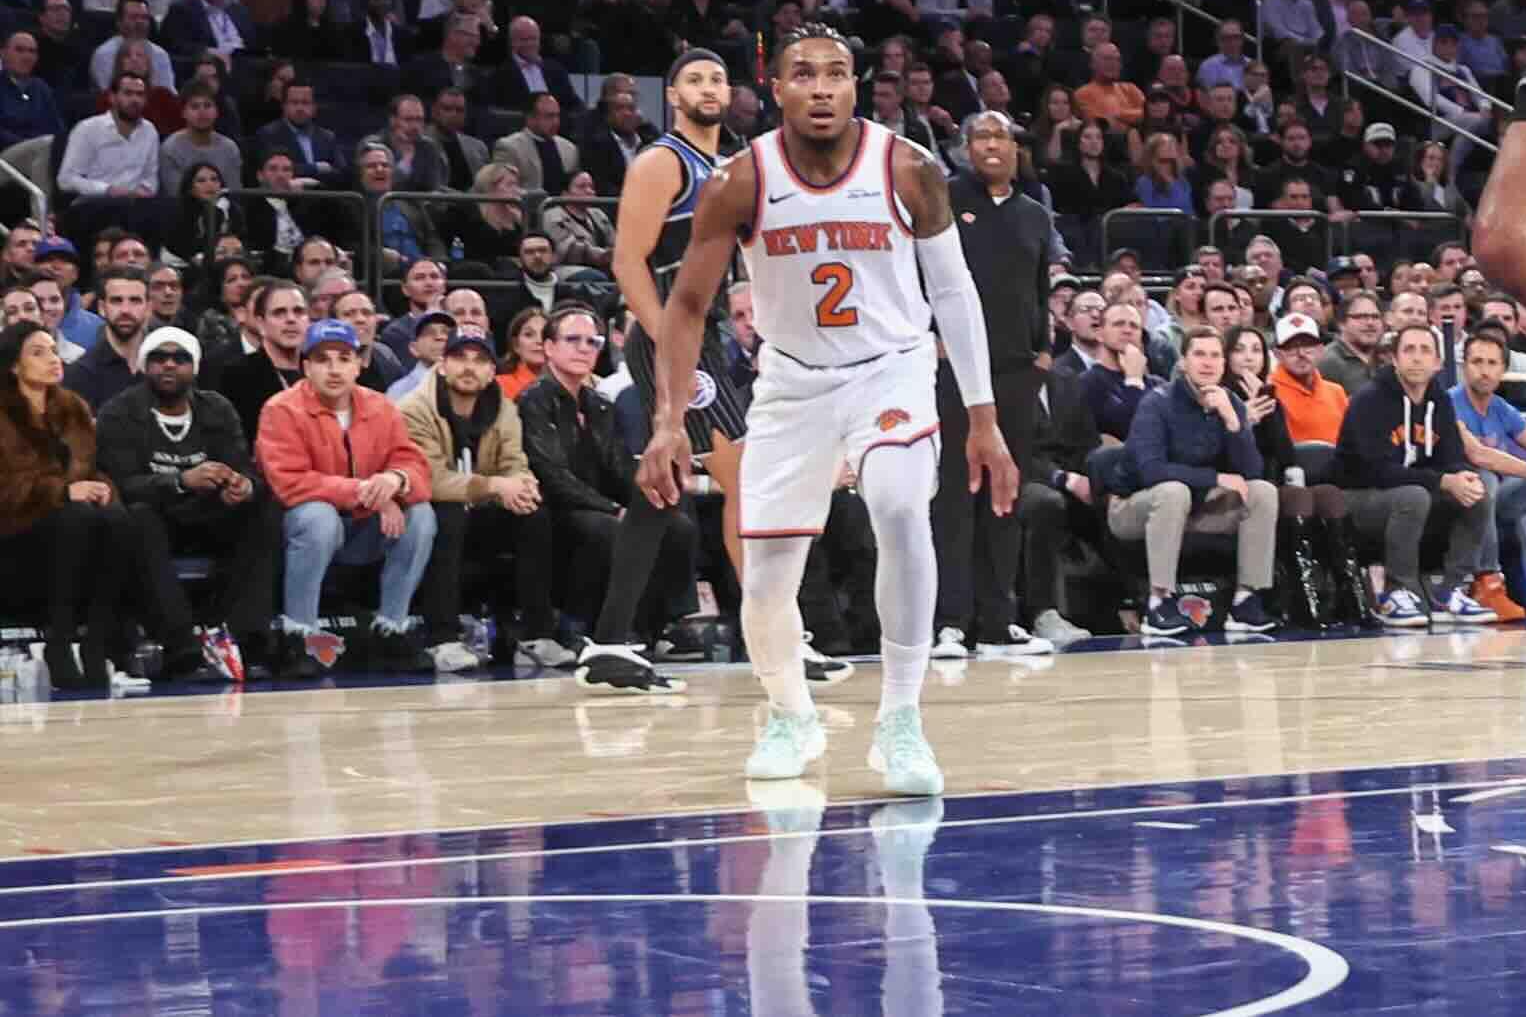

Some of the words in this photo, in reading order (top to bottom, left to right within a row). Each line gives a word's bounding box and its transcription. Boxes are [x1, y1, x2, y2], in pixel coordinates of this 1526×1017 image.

[761, 223, 817, 257] NEW
[817, 221, 893, 252] YORK
[810, 261, 859, 327] 2
